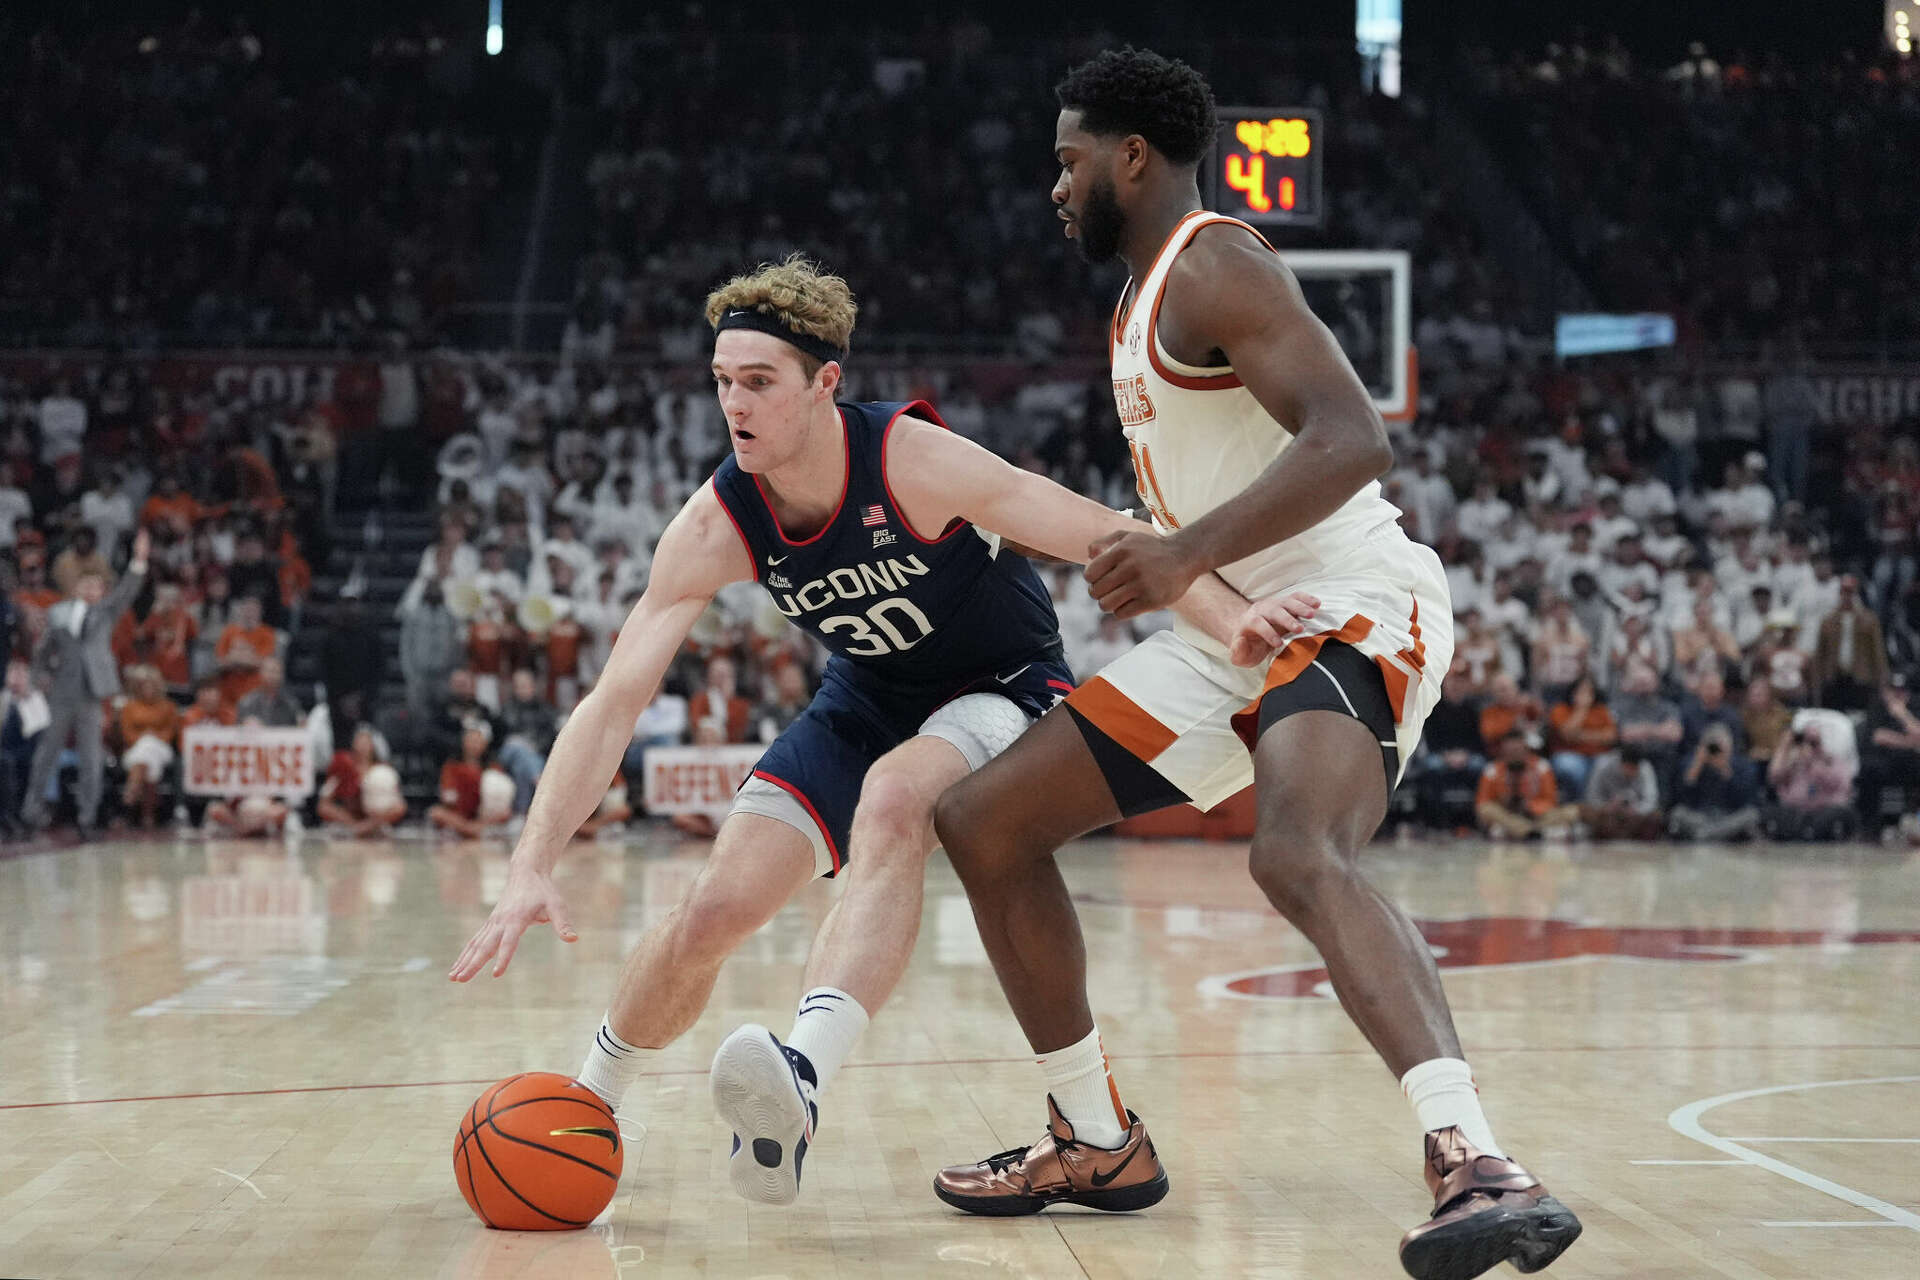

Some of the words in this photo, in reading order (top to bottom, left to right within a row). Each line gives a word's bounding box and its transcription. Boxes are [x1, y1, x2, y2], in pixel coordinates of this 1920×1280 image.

[873, 529, 889, 538] BIG
[873, 535, 897, 545] EAST
[768, 554, 931, 618] UCONN
[818, 597, 935, 657] 30
[193, 744, 303, 786] DEFENSE
